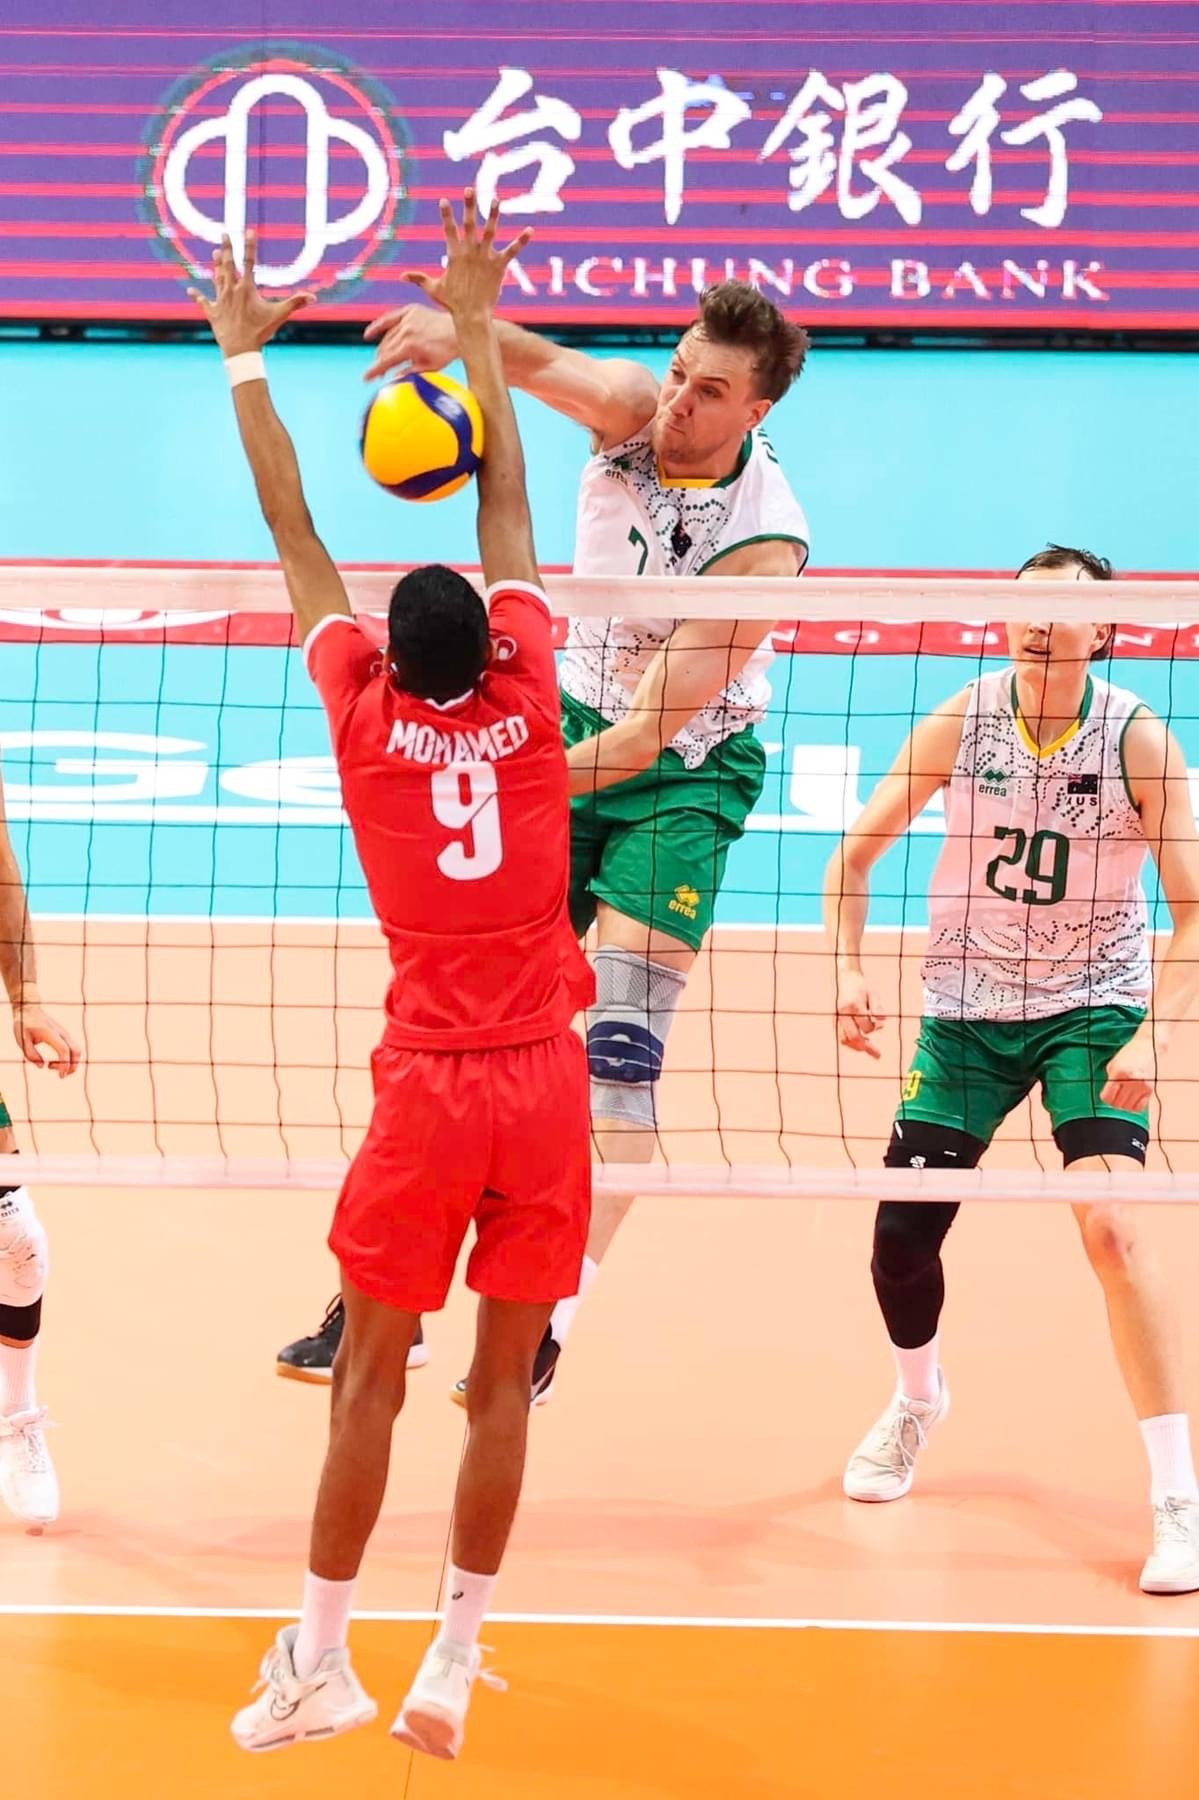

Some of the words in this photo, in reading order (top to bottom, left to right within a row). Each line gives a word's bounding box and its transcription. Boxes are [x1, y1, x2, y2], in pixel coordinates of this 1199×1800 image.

[442, 66, 1104, 229] 台中銀行
[441, 256, 854, 297] AICHUNG
[890, 258, 1110, 300] BANK
[386, 715, 530, 765] MOHAMED
[431, 760, 505, 881] 9
[986, 826, 1070, 905] 29
